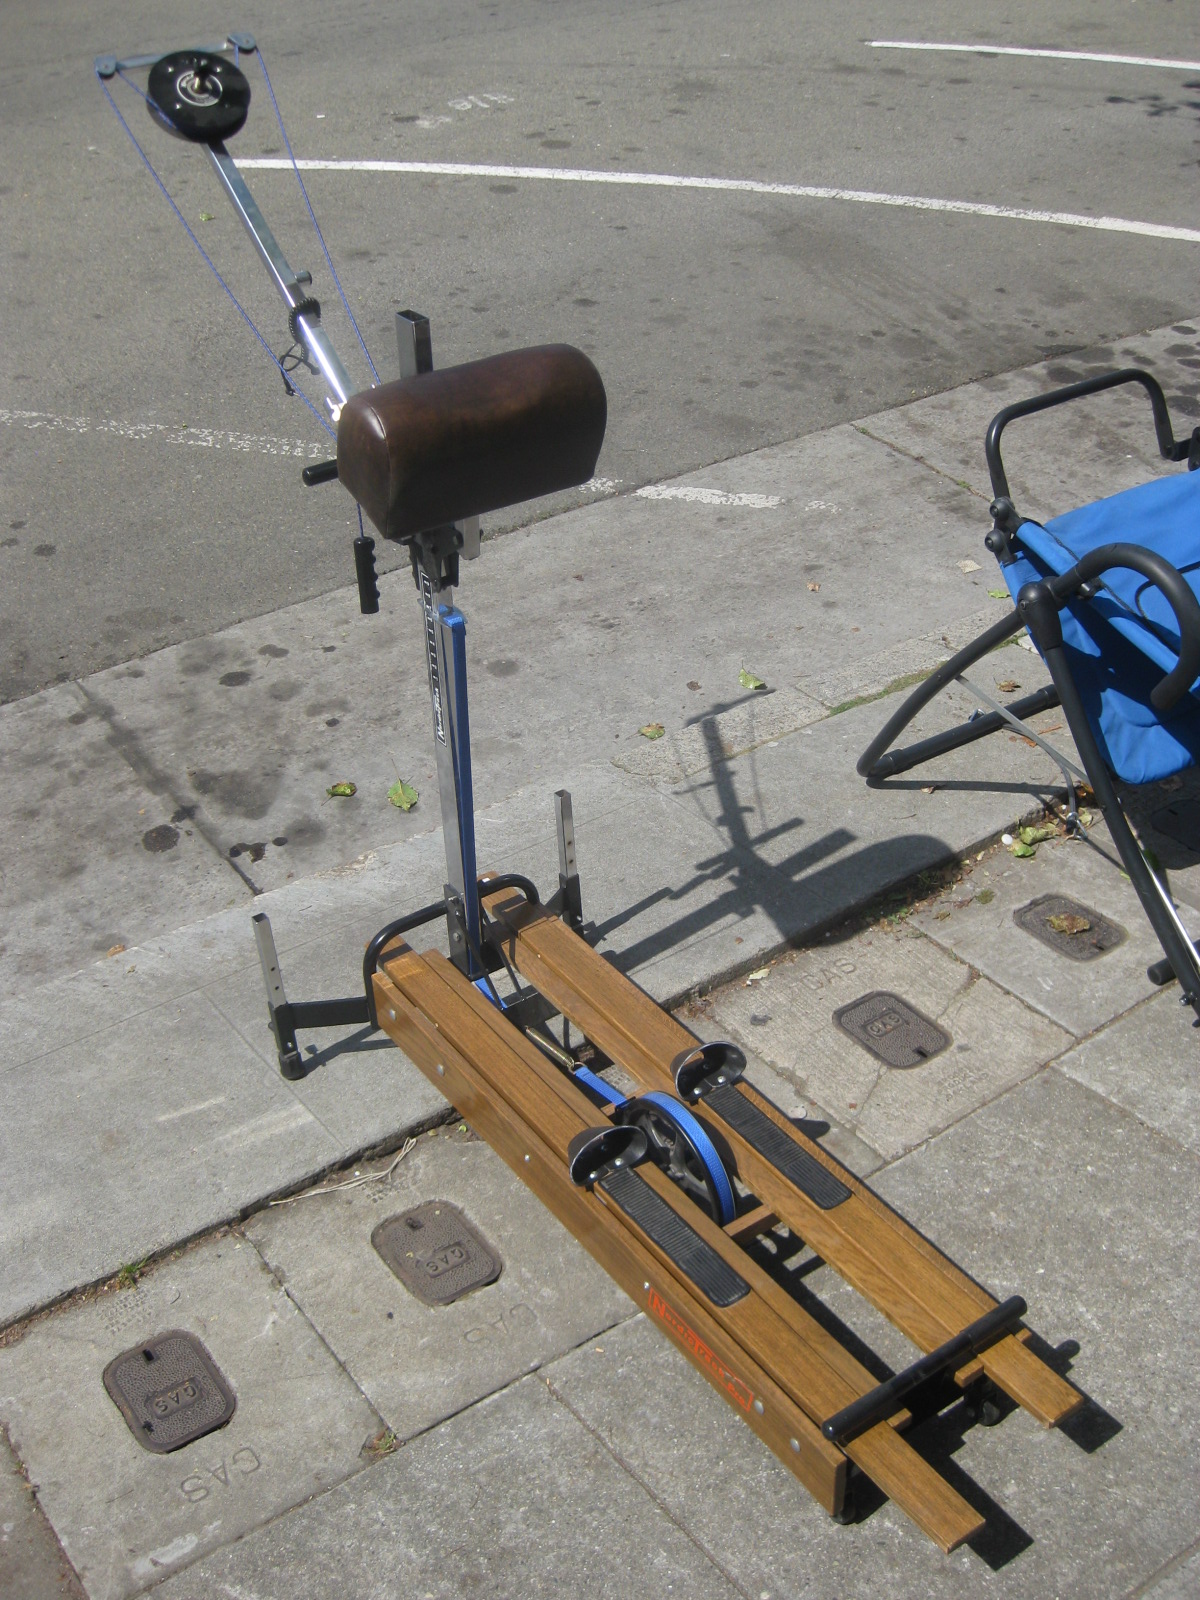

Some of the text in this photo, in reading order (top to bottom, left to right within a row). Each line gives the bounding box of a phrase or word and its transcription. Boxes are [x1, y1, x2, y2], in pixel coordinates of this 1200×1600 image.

[801, 957, 857, 991] GAS
[868, 1013, 901, 1037] GAS
[426, 1248, 464, 1272] GAS
[463, 1302, 538, 1344] GAS
[653, 1294, 725, 1379] NordicTrack
[155, 1383, 197, 1413] GAS
[181, 1447, 261, 1503] GAS
